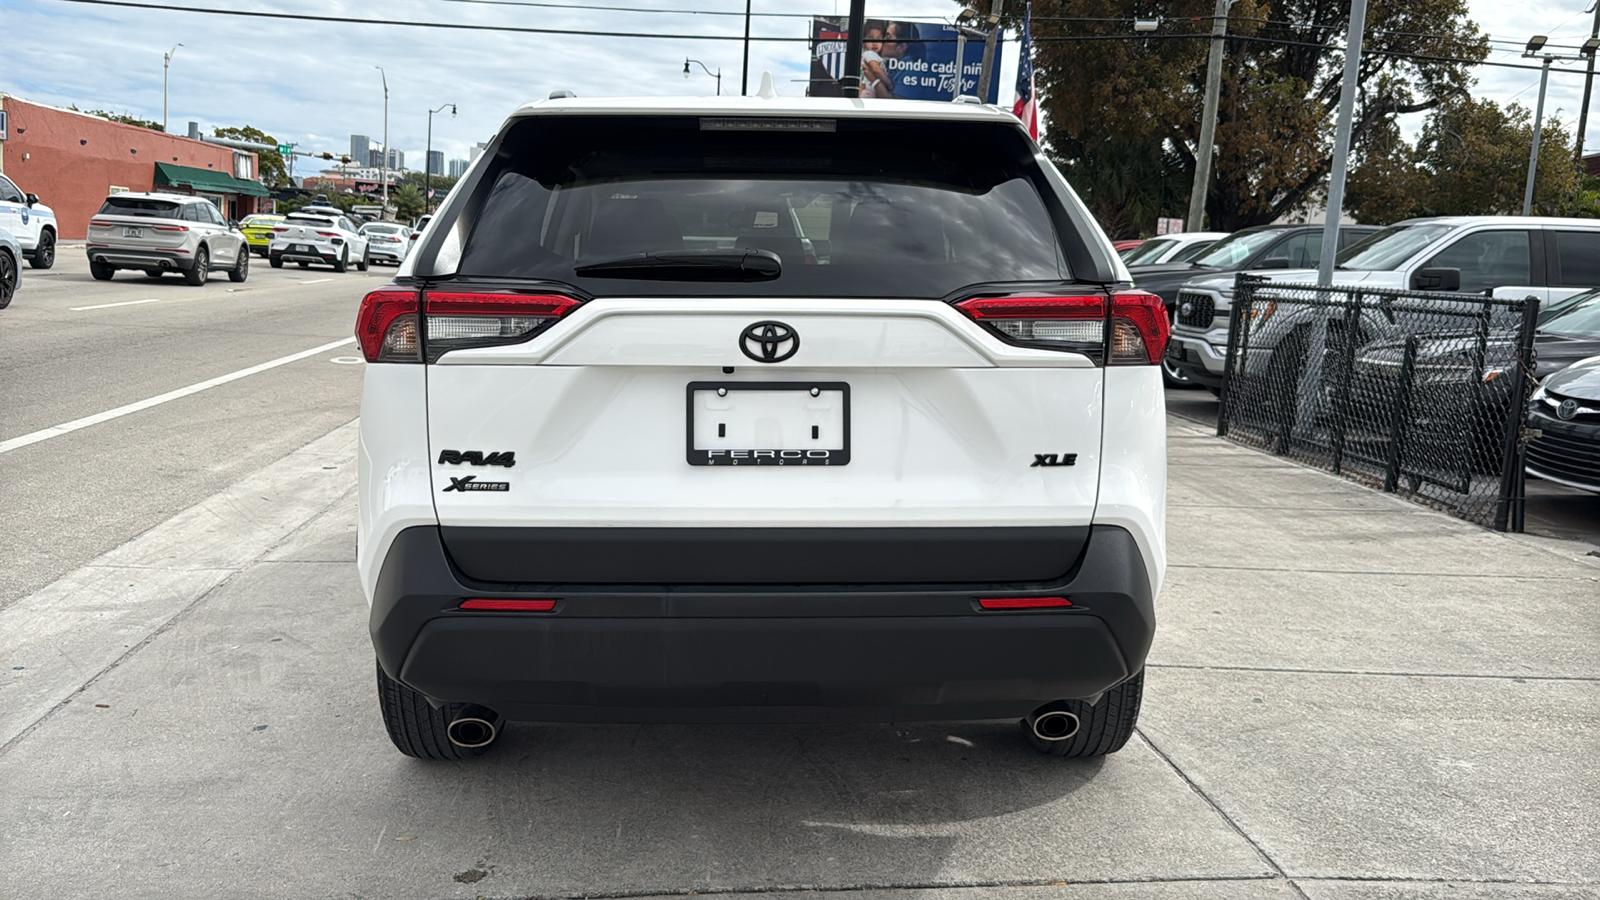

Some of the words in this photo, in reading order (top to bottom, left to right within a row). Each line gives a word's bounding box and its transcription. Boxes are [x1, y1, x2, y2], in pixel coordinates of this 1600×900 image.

[888, 58, 928, 72] Donde
[963, 62, 982, 75] niñ
[902, 75, 918, 86] es
[920, 76, 937, 87] un
[937, 74, 976, 92] Tesro
[438, 450, 516, 468] RAV4
[708, 449, 830, 458] FERCO
[1030, 453, 1078, 467] XLE
